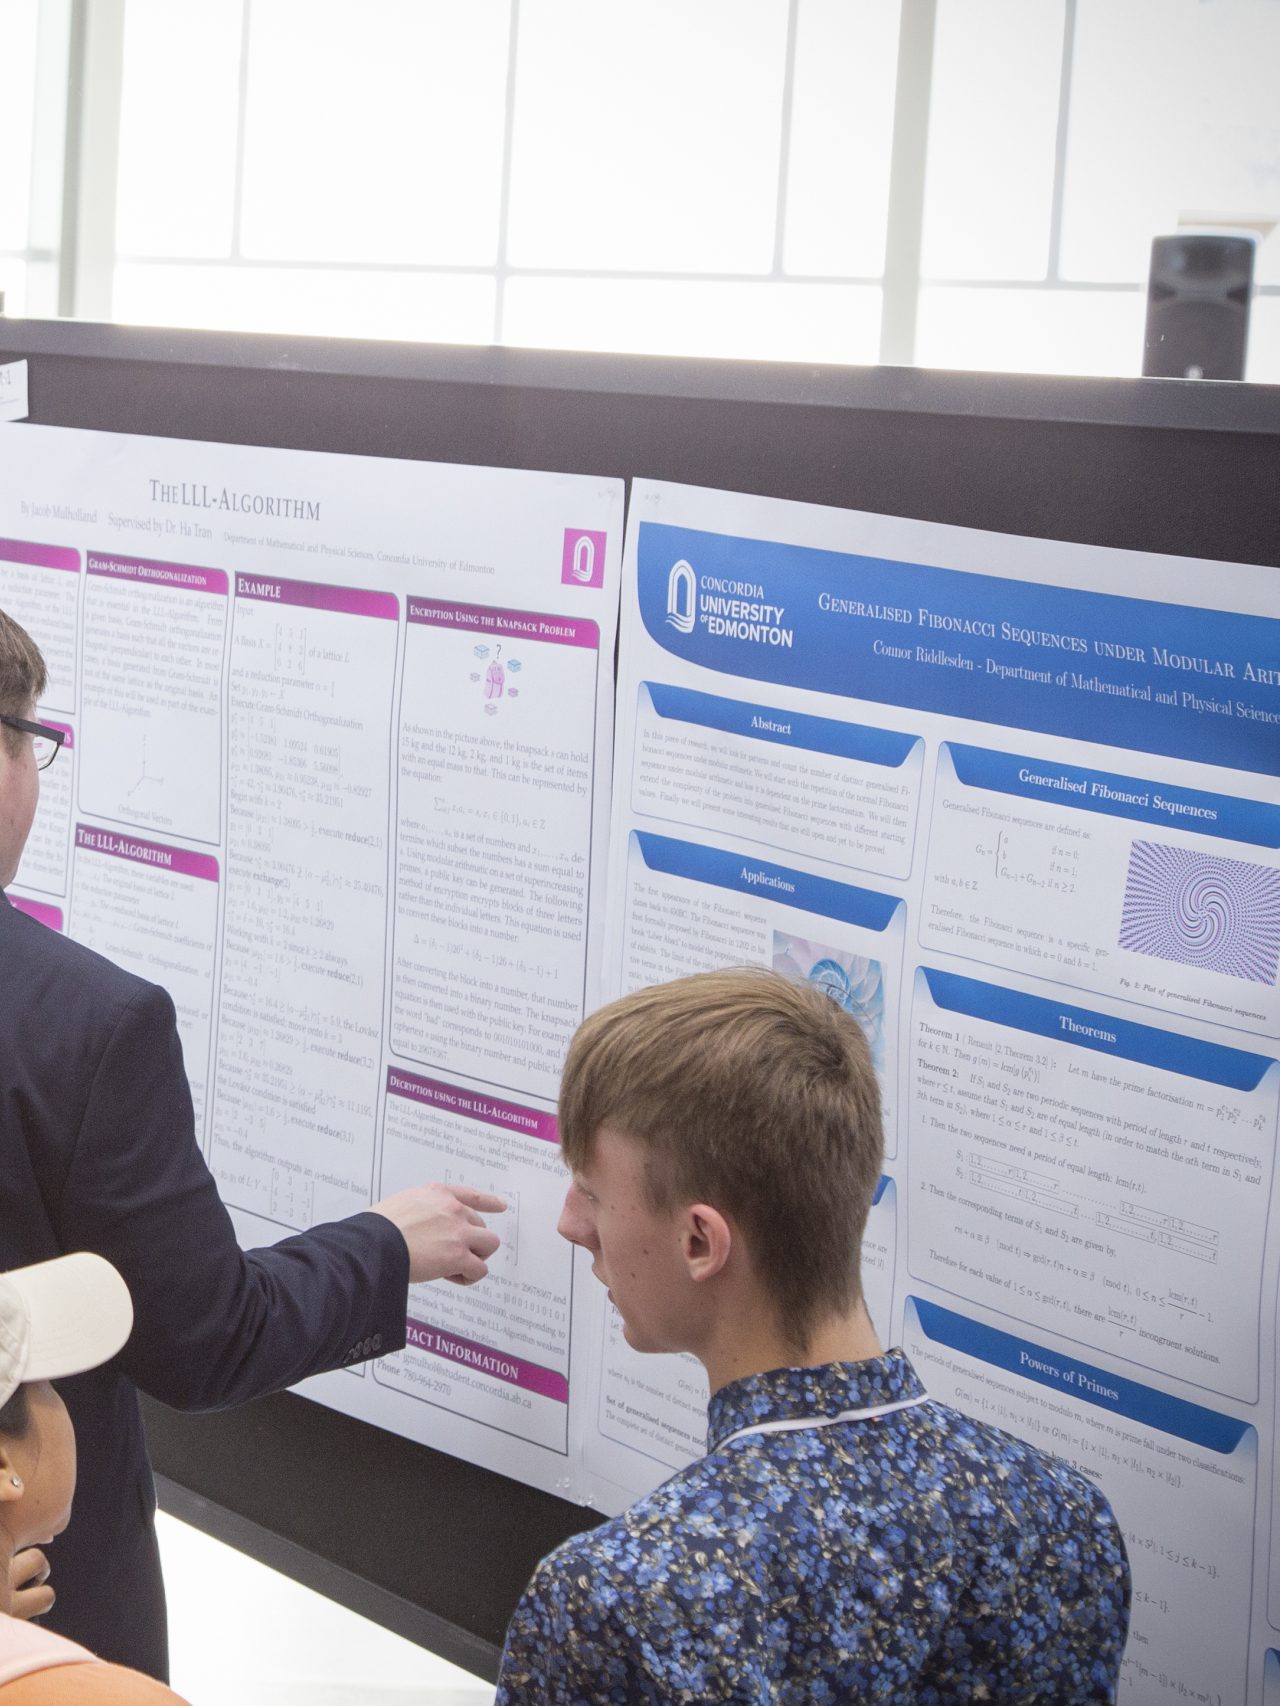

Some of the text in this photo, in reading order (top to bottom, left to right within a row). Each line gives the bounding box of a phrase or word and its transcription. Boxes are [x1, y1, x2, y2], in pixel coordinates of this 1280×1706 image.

[88, 559, 207, 585] GRAM-SCHMIDT ORTHOGONALIZATION
[700, 575, 764, 599] CONCORDIA
[238, 579, 281, 598] EXAMPLE
[409, 605, 575, 637] ENCRYPTION USING THE KNAPSACK PROBLEM
[700, 594, 783, 625] UNIVERSITY
[708, 620, 793, 648] EDMONTON
[818, 594, 912, 624] GENERALISED
[918, 610, 995, 638] FIBONACCI
[1001, 624, 1087, 654] SEQUENCES
[1094, 640, 1144, 663] UNDER
[1152, 649, 1234, 678] MODULAR
[872, 642, 910, 660] Connor
[915, 646, 973, 670] Riddlesden
[985, 661, 1050, 684] Department
[1055, 670, 1066, 686] of
[1071, 673, 1151, 701] Mathematical
[1155, 691, 1177, 706] and
[1182, 691, 1232, 715] Physical
[751, 717, 790, 734] Abstract
[1018, 768, 1216, 820] Generalised Fibonacci Sequences
[78, 829, 172, 868] THE LLL-ALGORITHM
[741, 869, 794, 893] Applications
[919, 1022, 952, 1039] Theorem
[1060, 1016, 1116, 1043] Theorems
[389, 1076, 538, 1129] DECRYPTION USING THE LLL-ALGORITHM
[406, 1326, 518, 1379] TACT INFORMATION
[1138, 1329, 1219, 1364] incongruent solutions.
[1020, 1354, 1118, 1400] Powers of Primes
